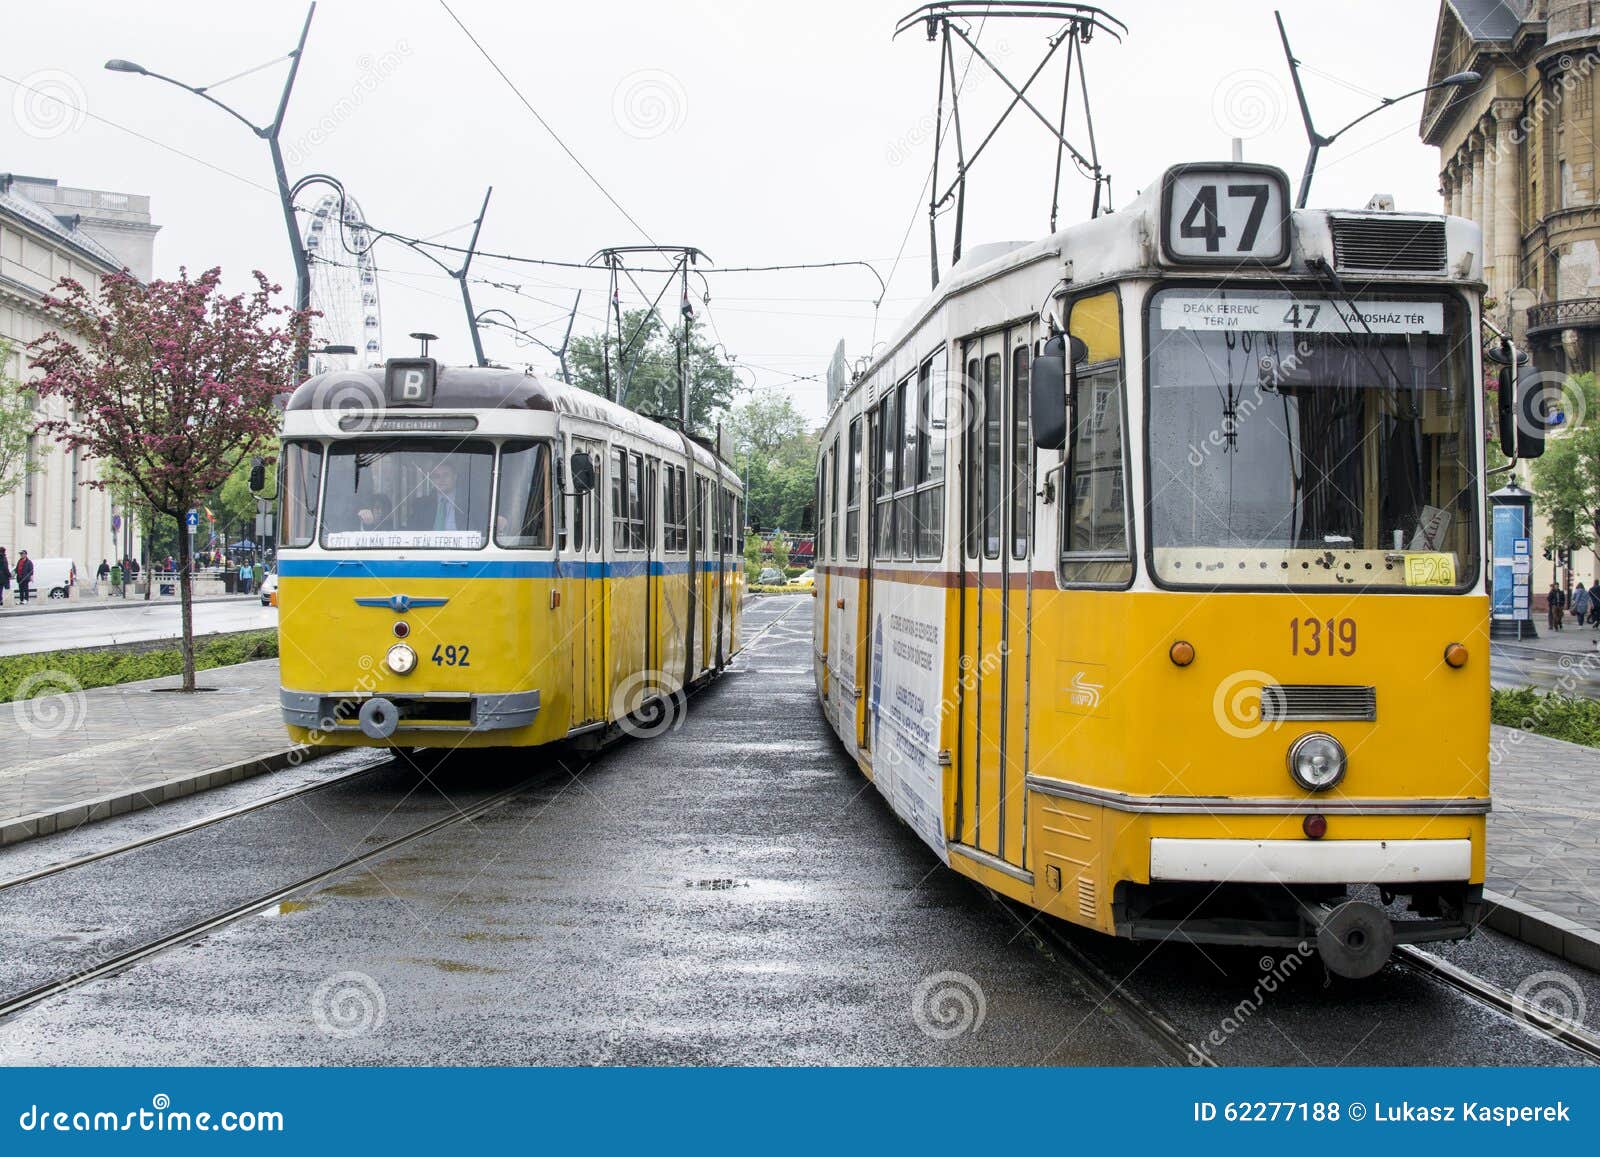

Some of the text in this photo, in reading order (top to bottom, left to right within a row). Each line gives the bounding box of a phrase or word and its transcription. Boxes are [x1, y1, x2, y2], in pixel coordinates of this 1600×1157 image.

[1180, 184, 1270, 252] 47
[1217, 303, 1260, 315] FERENC
[1227, 316, 1239, 326] M
[1282, 304, 1321, 329] 47
[1404, 312, 1425, 325] TÉR
[402, 370, 424, 399] B
[1409, 556, 1452, 585] F26
[1290, 616, 1357, 657] 1319
[431, 643, 470, 667] 492
